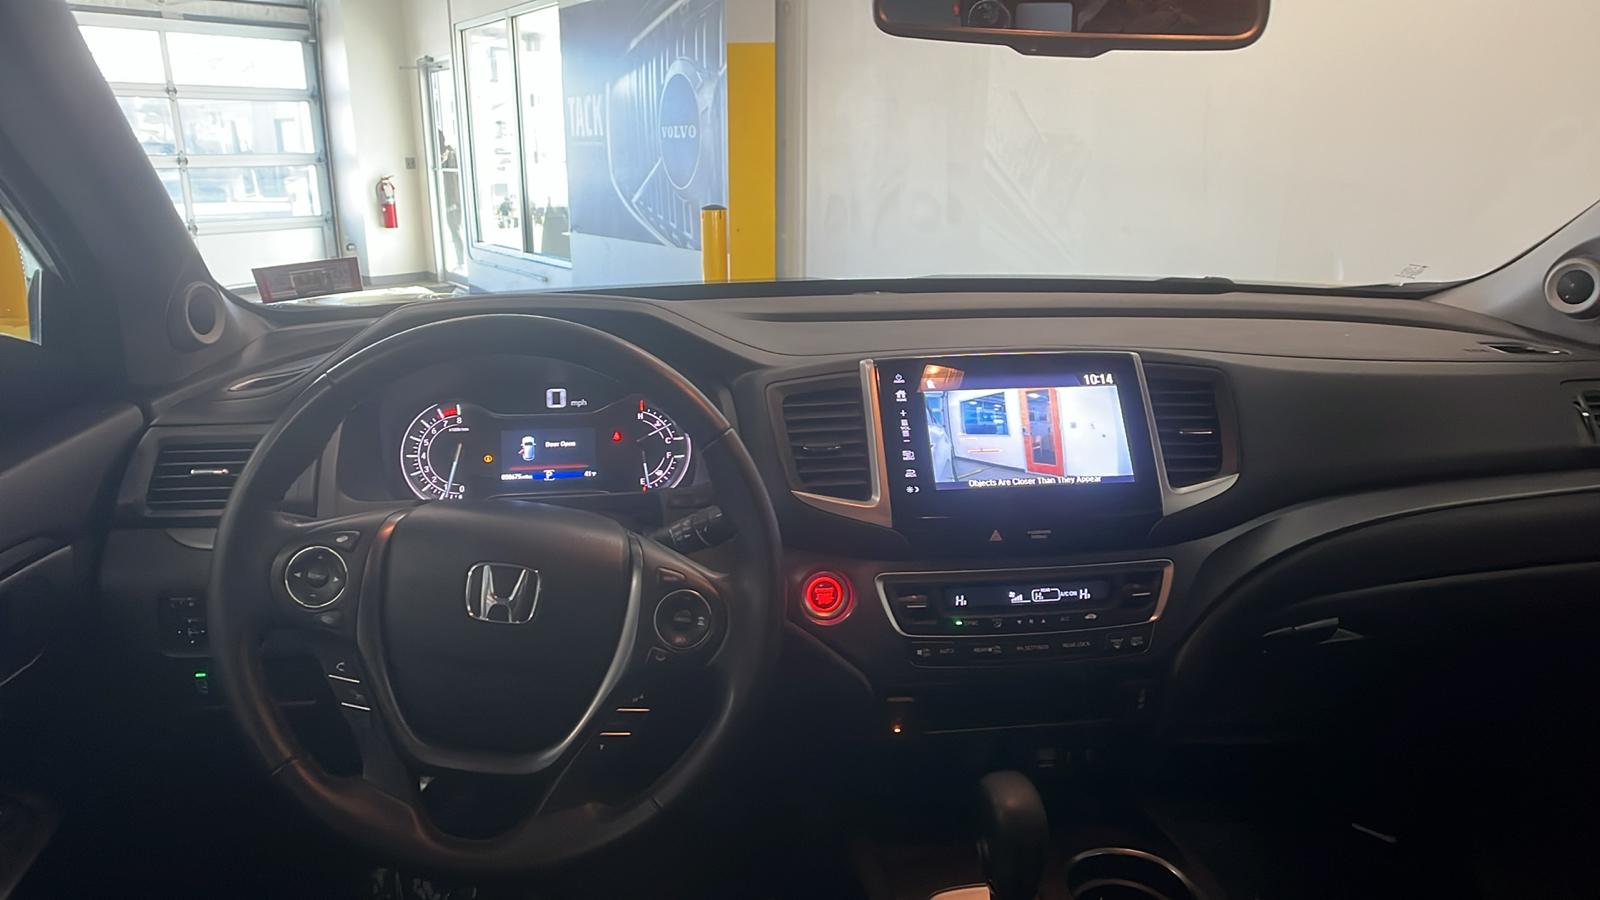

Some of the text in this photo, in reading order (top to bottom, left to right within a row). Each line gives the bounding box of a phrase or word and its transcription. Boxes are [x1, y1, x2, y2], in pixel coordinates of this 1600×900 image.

[567, 94, 604, 137] TACK
[661, 125, 697, 139] VOLVO
[1083, 373, 1114, 385] 10:14
[546, 388, 588, 408] 0 mph
[560, 440, 577, 448] Open
[421, 452, 427, 460] 4
[666, 451, 672, 459] F
[639, 477, 646, 485] E
[968, 476, 1102, 488] Objects Are Closer Than They Appear
[458, 485, 465, 493] 0
